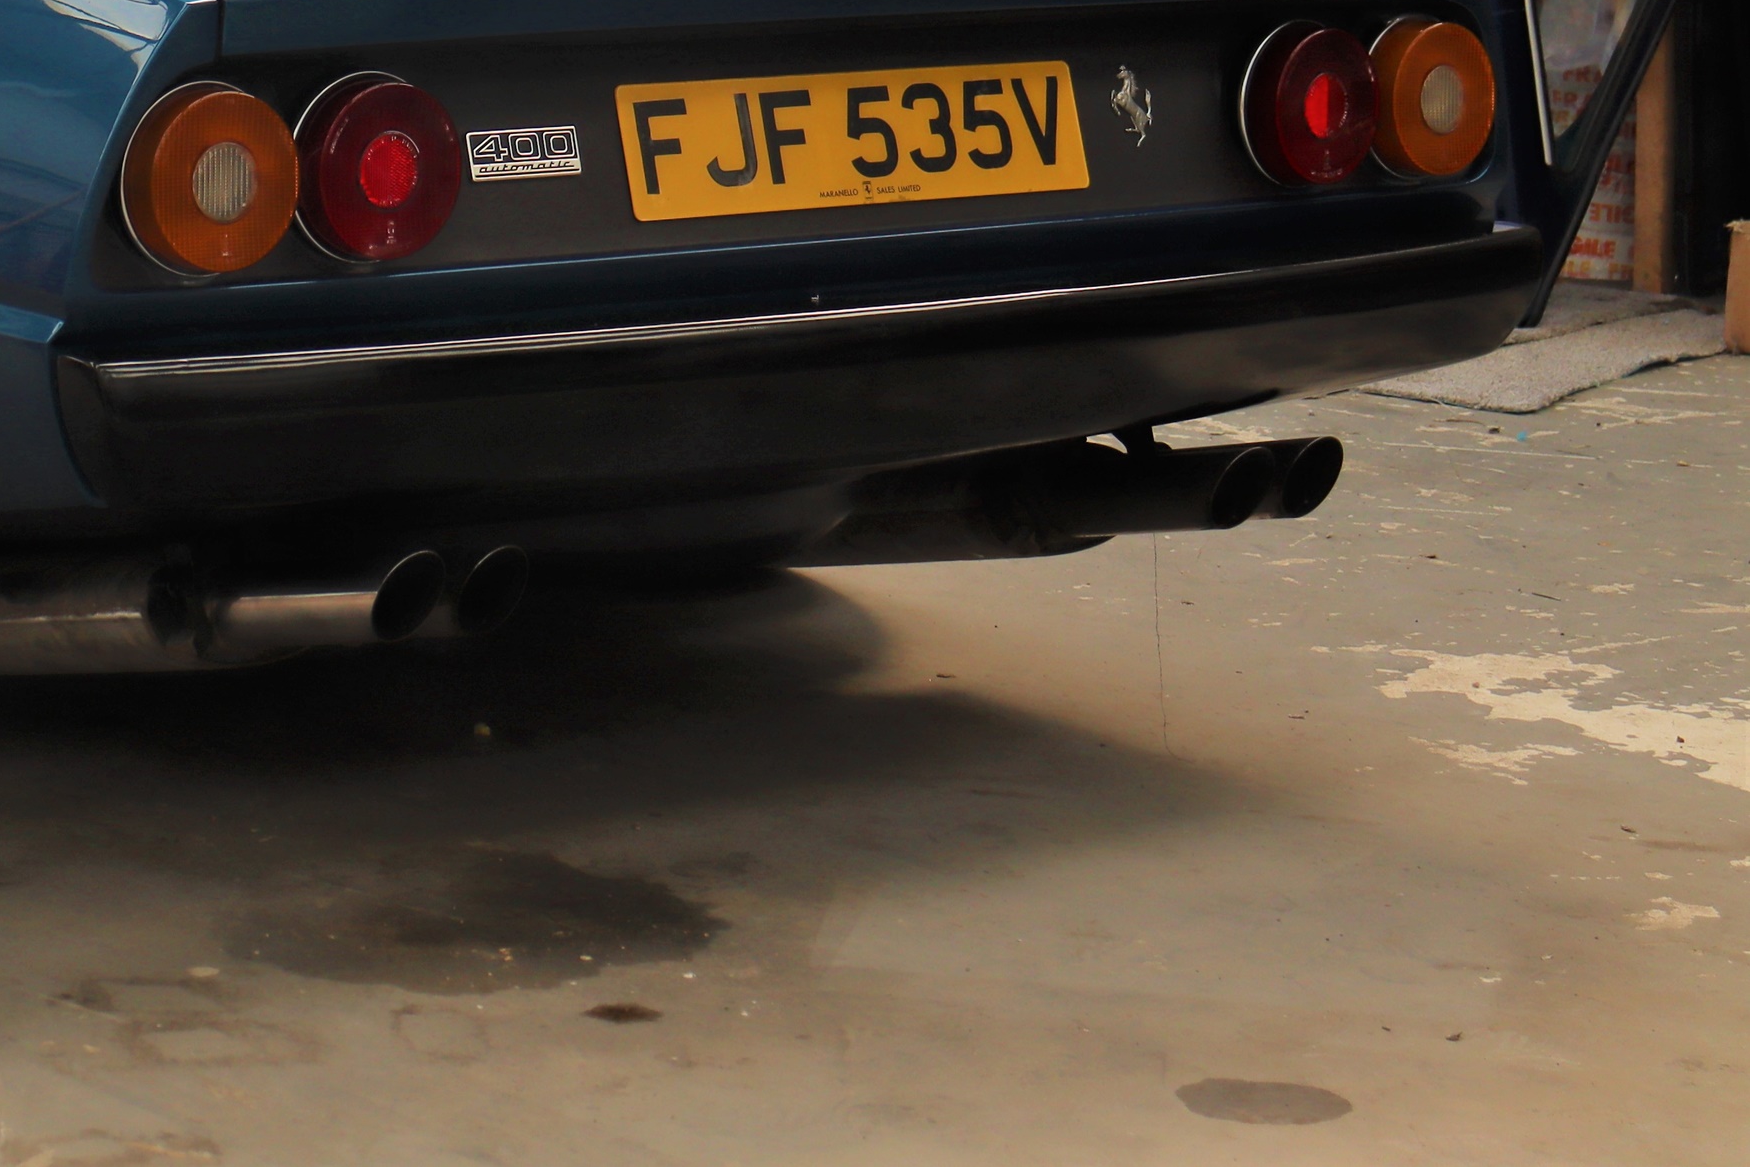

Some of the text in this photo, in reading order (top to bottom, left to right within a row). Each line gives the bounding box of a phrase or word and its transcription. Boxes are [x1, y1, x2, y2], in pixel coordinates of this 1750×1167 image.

[473, 130, 575, 162] 400
[632, 76, 1058, 195] FJF 535V
[479, 160, 575, 174] automatic
[819, 184, 921, 198] MARANELLO SALES LIMITED
